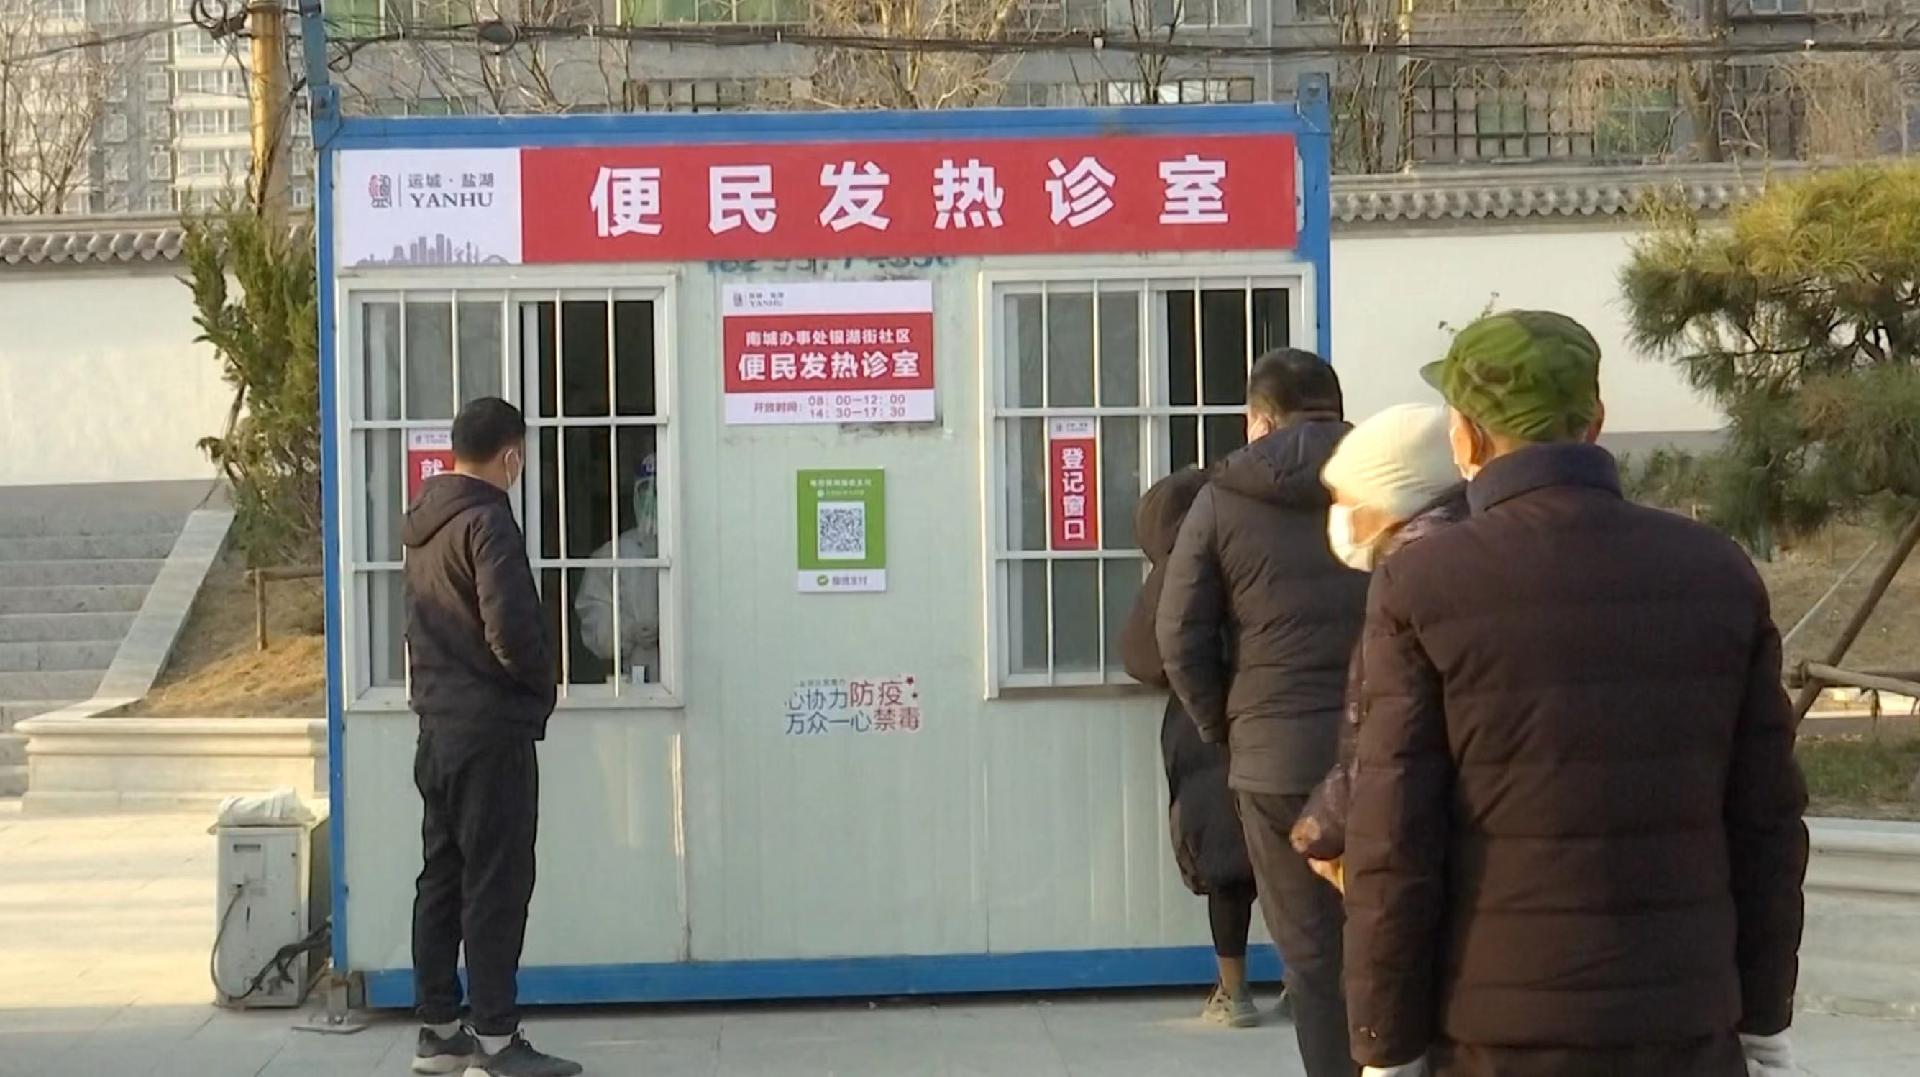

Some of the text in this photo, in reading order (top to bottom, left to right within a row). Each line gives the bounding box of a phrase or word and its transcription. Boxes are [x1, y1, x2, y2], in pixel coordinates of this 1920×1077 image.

[407, 172, 494, 188] 运城·盐湖
[409, 193, 493, 208] YANHU
[590, 154, 1229, 239] 便民发热诊室
[738, 350, 920, 381] 便民发热诊室
[1062, 447, 1085, 540] 登记窗口
[785, 707, 919, 735] 万众一心禁毒
